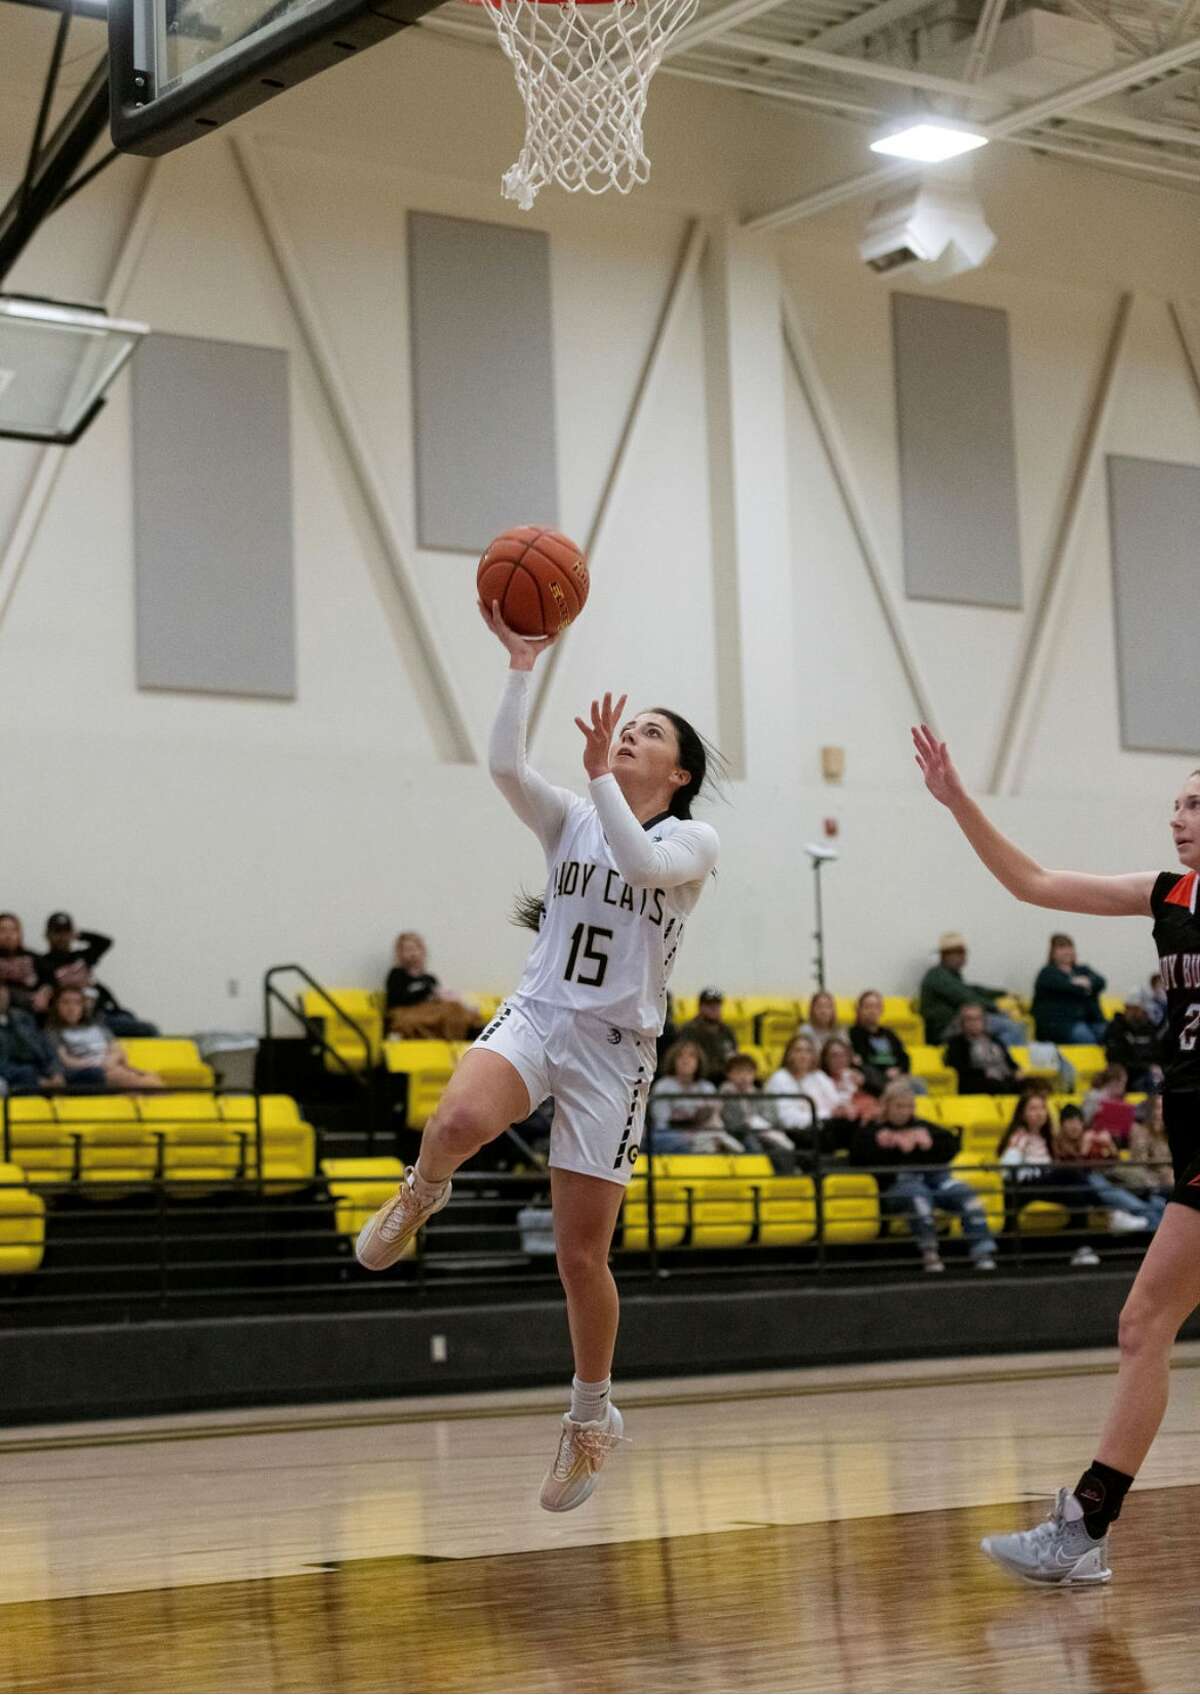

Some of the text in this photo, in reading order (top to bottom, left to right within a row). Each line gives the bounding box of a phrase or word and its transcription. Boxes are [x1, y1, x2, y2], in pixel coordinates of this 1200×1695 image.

[553, 861, 666, 926] ADY CATS
[563, 922, 613, 987] 15
